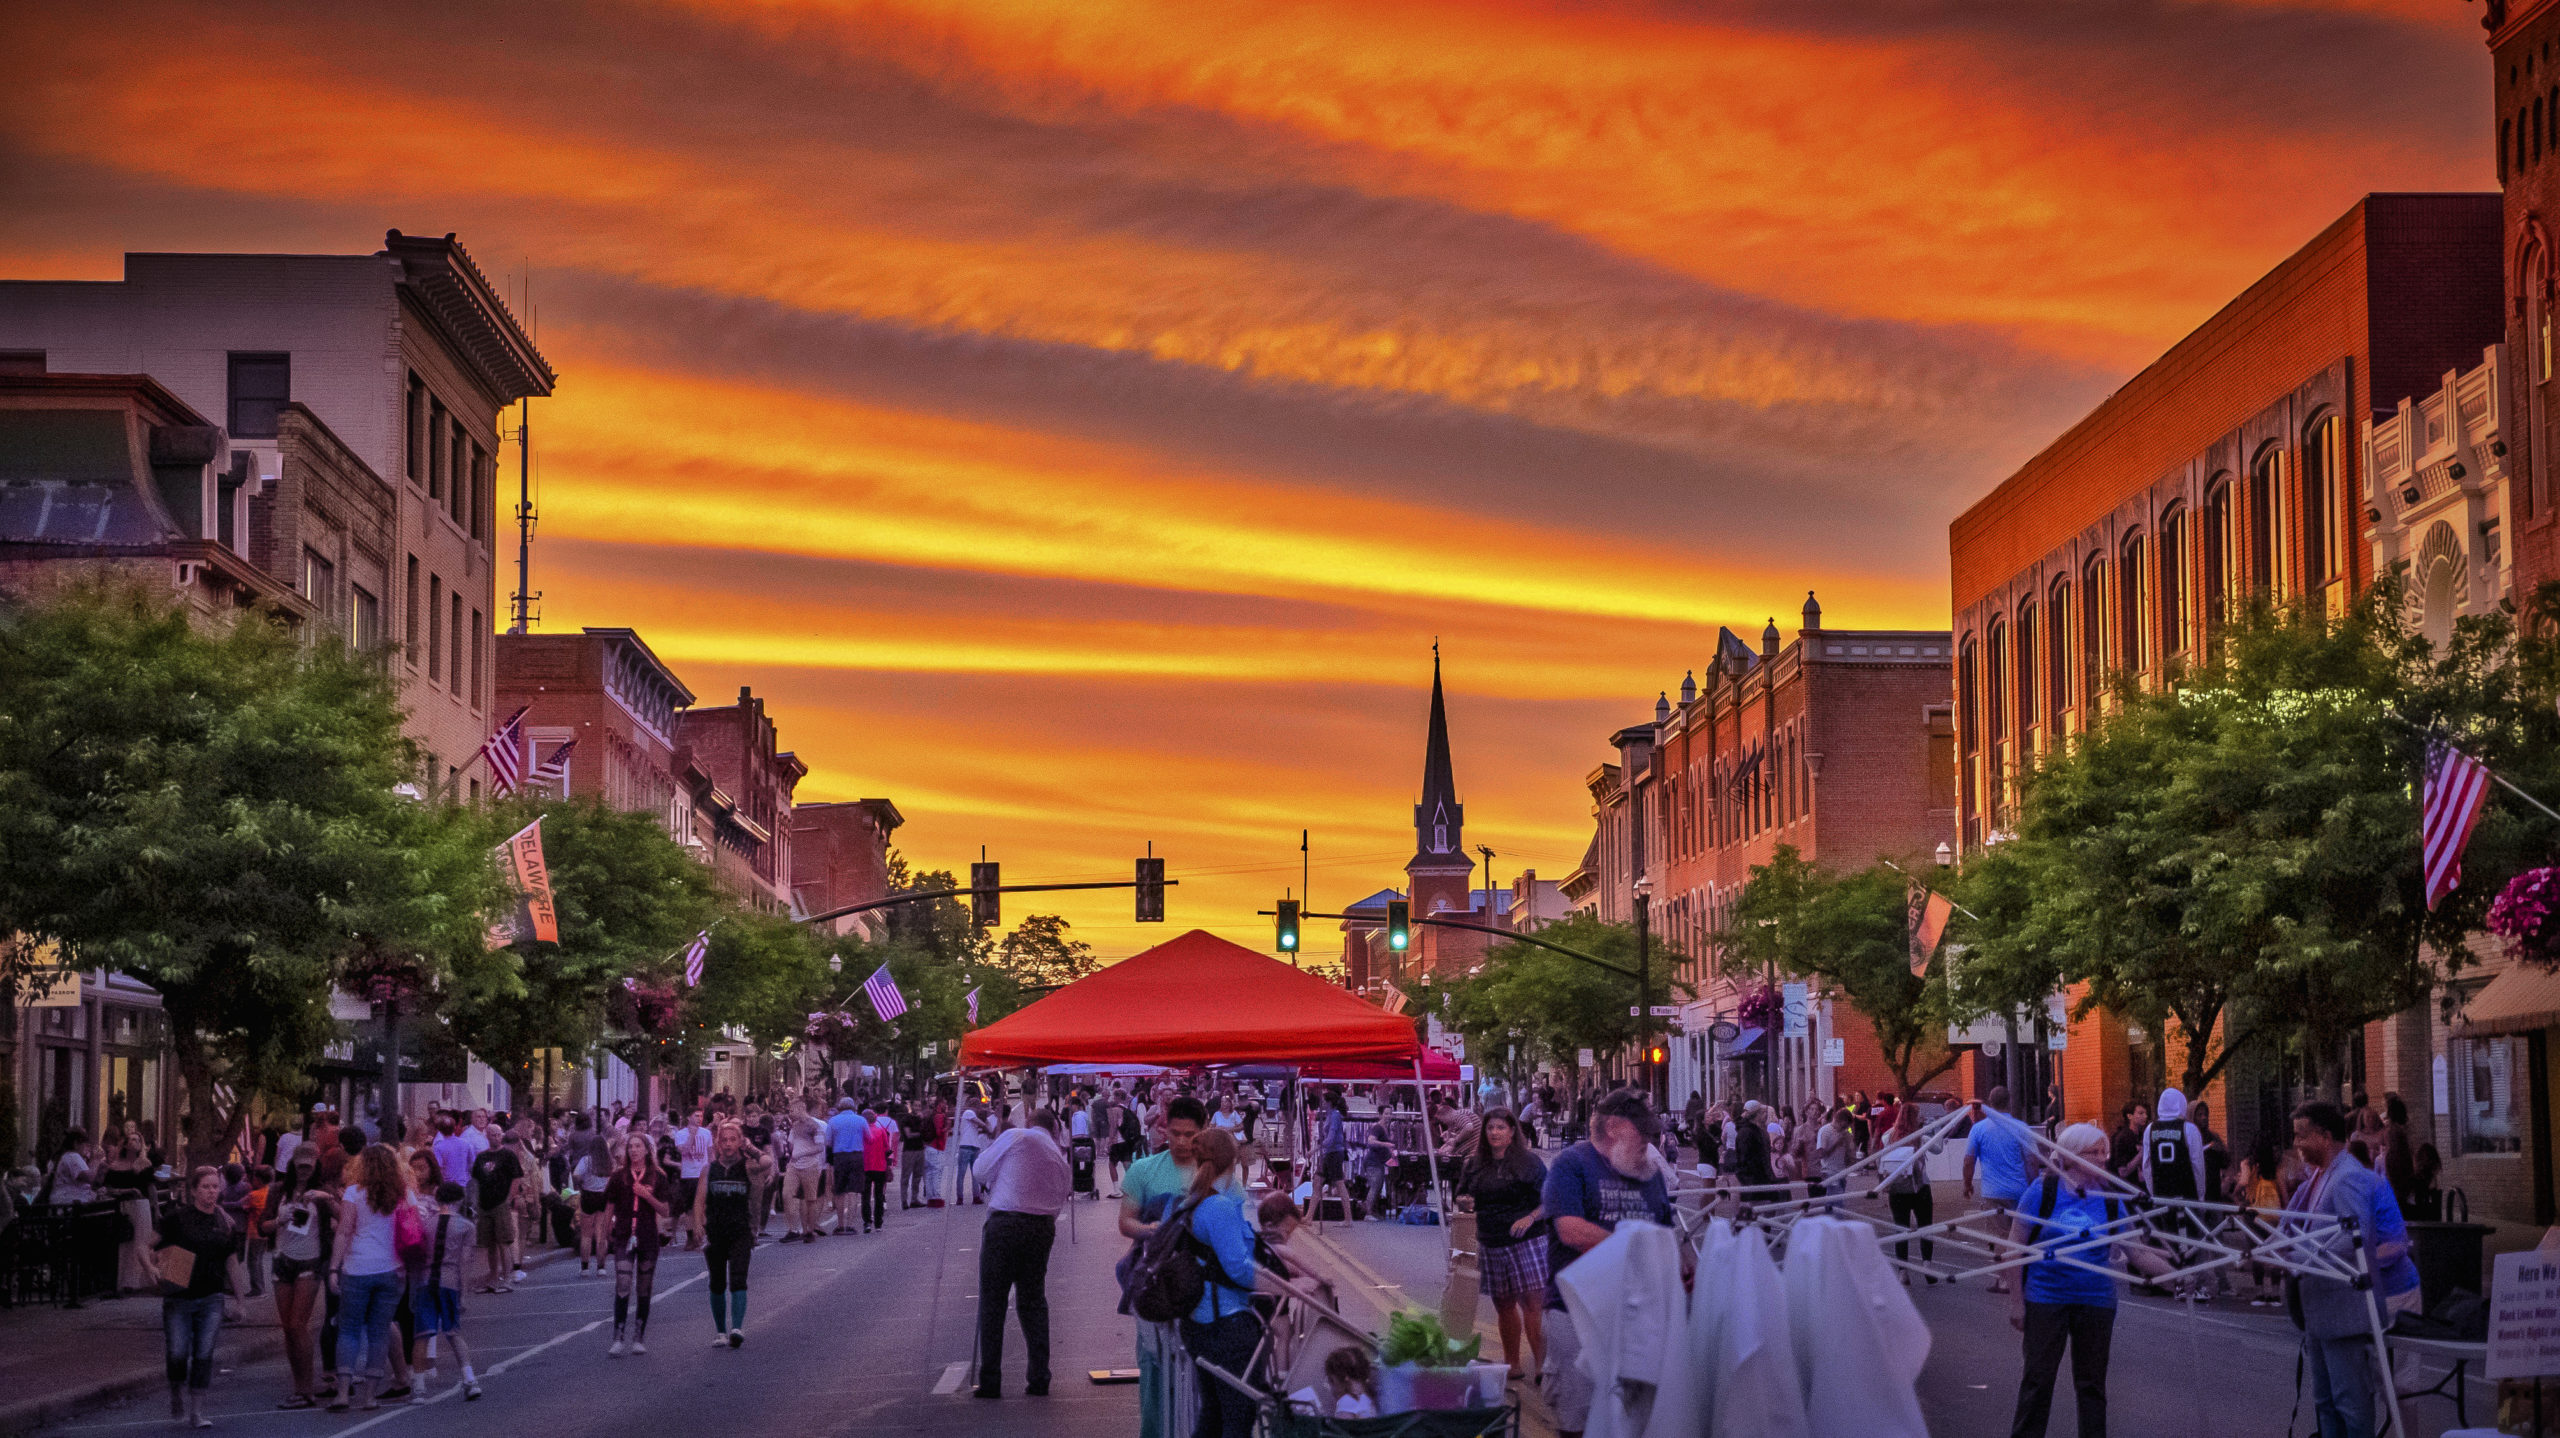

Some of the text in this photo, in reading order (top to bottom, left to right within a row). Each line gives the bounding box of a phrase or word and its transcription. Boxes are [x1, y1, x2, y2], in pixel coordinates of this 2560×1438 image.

[2158, 1142, 2175, 1162] 0
[2518, 1263, 2557, 1283] Here We
[2499, 1307, 2557, 1322] Black Lives Matter
[2526, 1325, 2549, 1341] Rights
